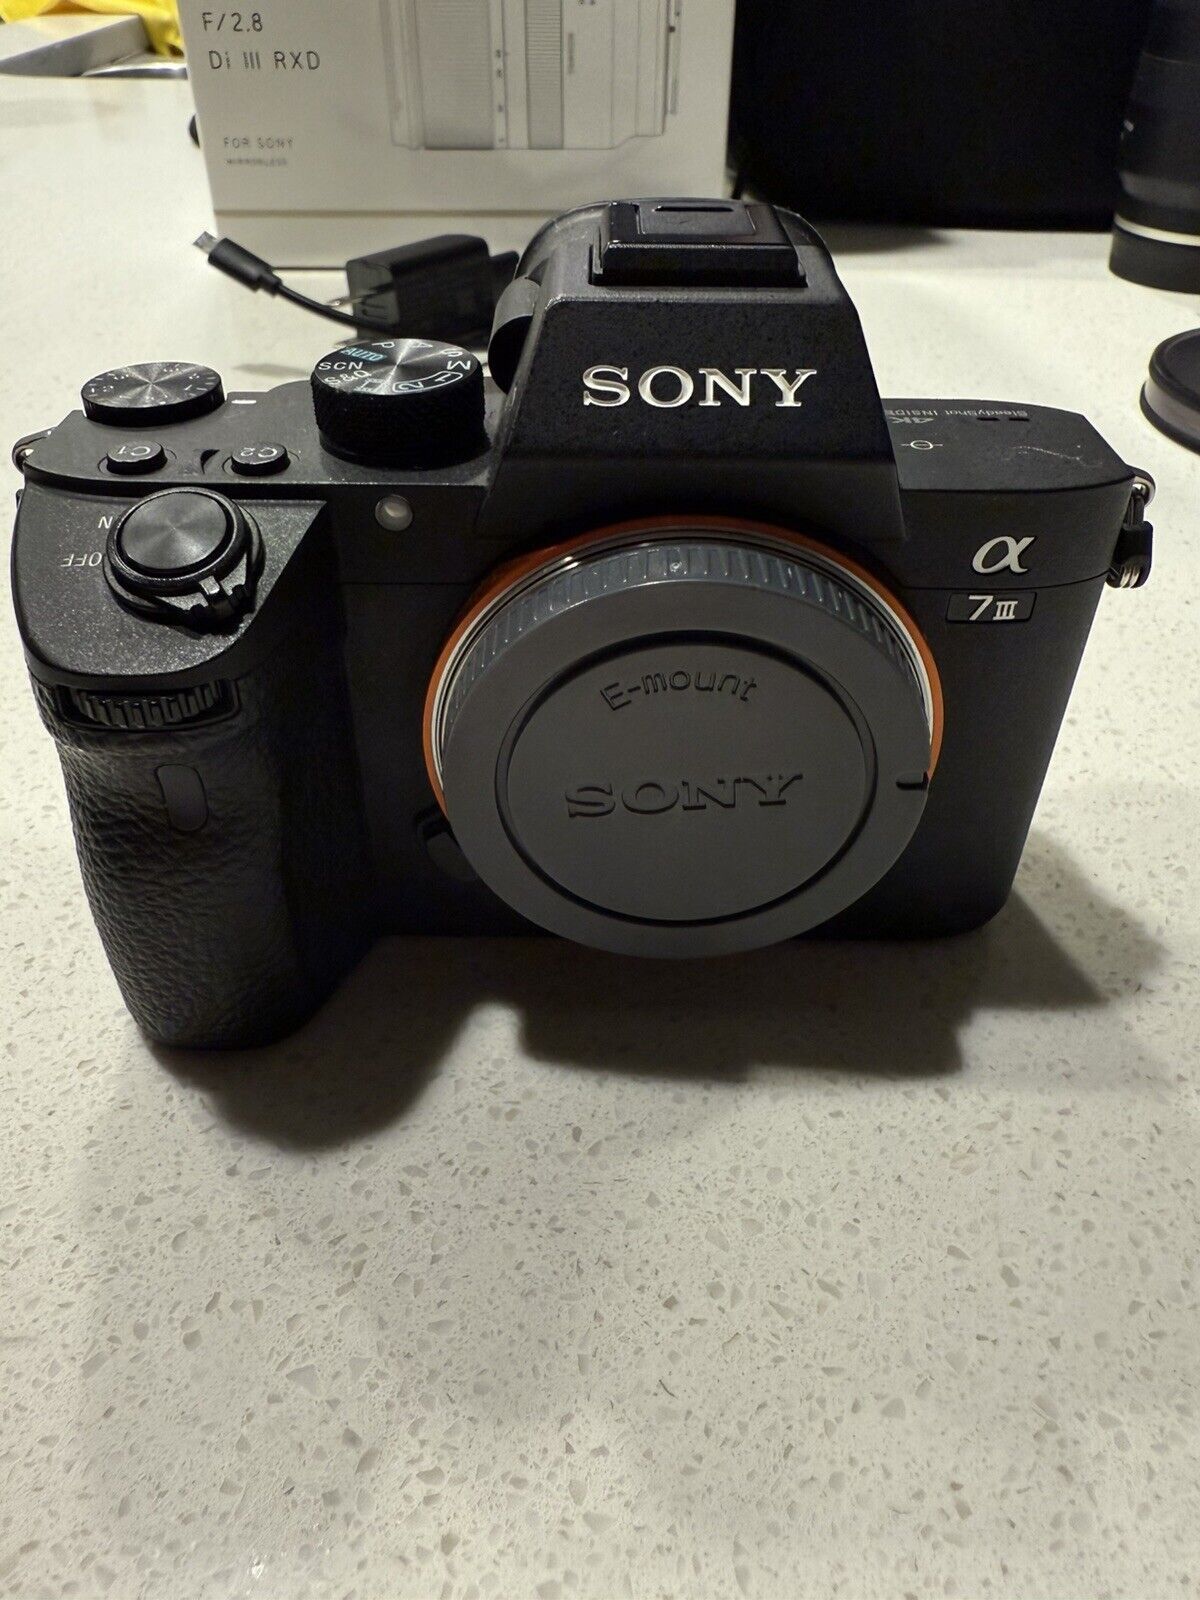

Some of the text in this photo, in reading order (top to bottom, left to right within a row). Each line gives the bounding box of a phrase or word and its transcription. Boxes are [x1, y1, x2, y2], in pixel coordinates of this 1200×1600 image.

[202, 12, 263, 32] F/2.8
[208, 50, 231, 70] Di
[273, 50, 320, 70] RXD
[223, 136, 250, 149] FOR
[340, 347, 387, 362] AUTO
[318, 361, 363, 371] SCN
[447, 360, 471, 370] M
[324, 370, 372, 386] S&Q
[582, 365, 817, 408] SONY
[118, 446, 150, 456] C1
[241, 447, 278, 458] C2
[60, 552, 102, 567] OFF
[600, 671, 757, 711] E-mount
[564, 774, 804, 819] SONY
